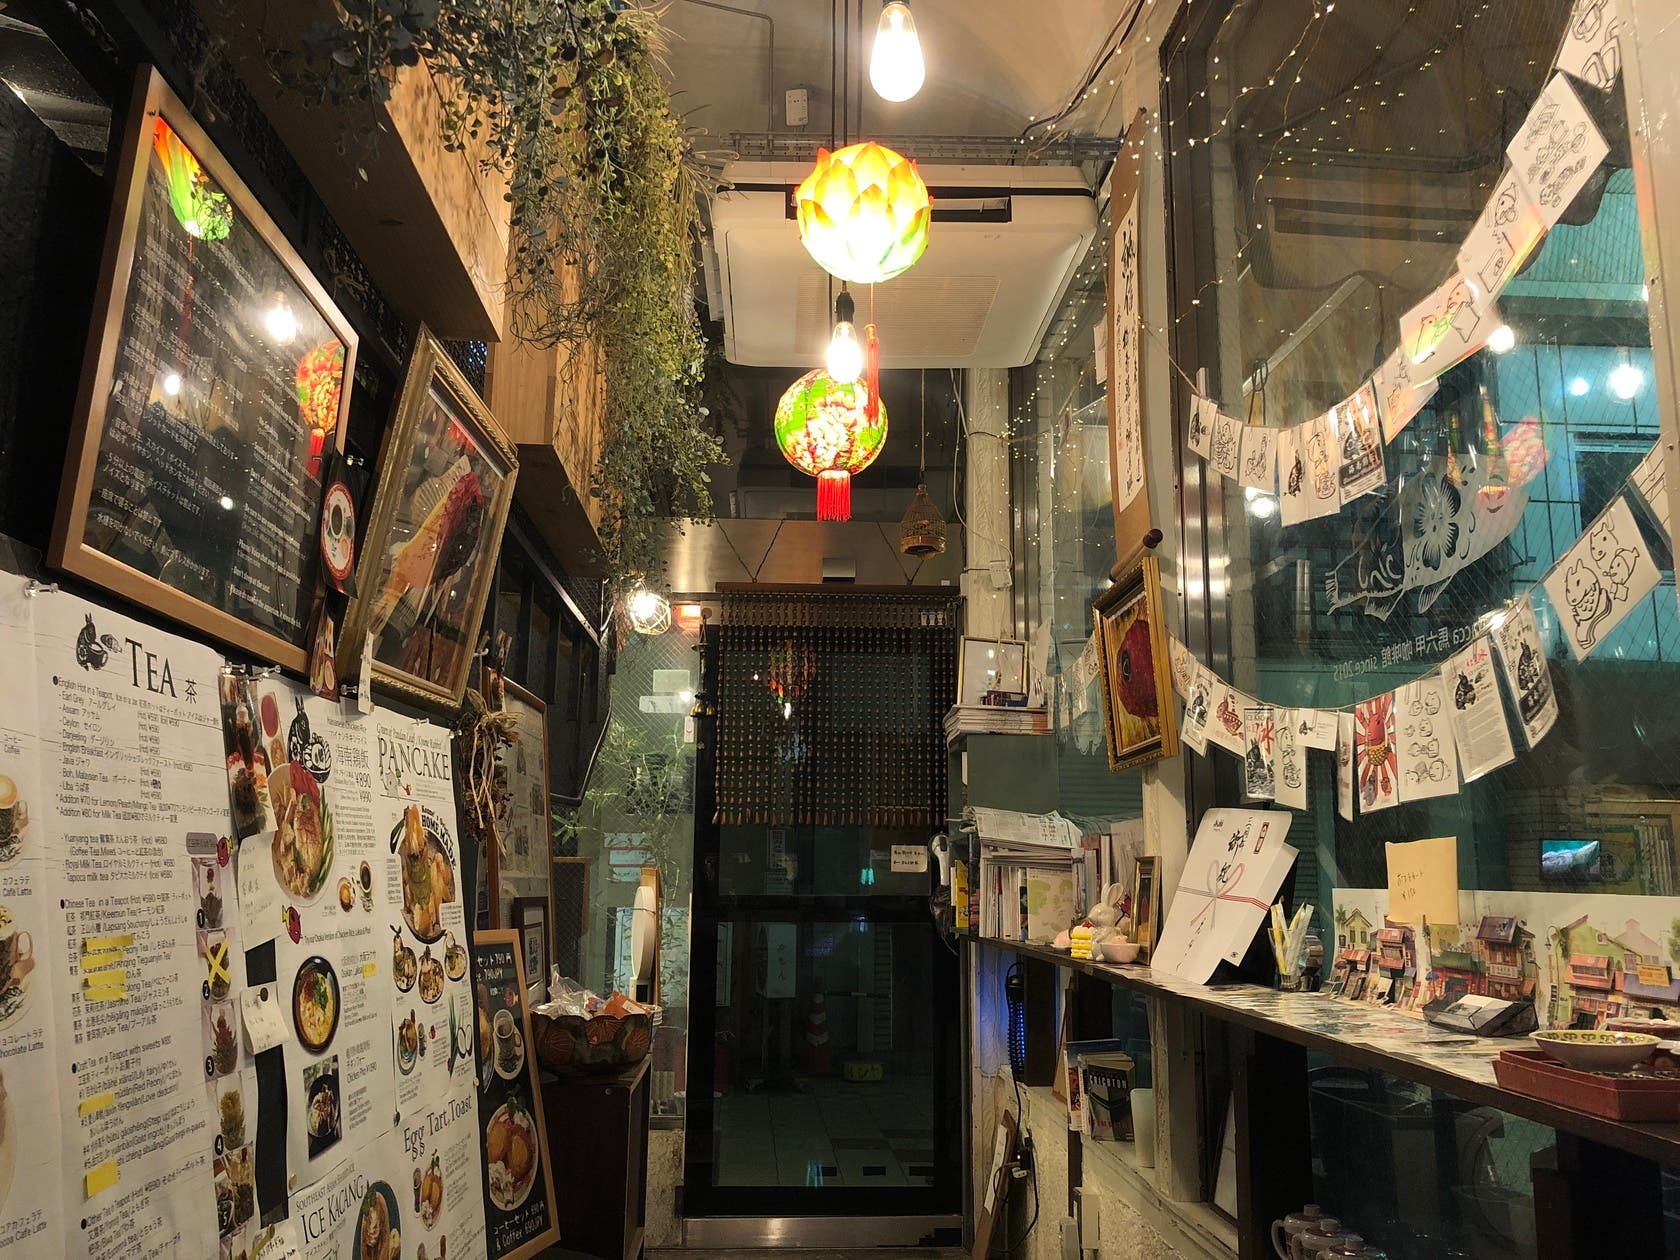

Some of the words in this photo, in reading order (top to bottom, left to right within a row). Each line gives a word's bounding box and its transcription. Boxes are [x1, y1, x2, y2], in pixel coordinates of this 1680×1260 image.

[125, 637, 178, 698] TEA
[185, 678, 198, 704] 茶
[62, 705, 79, 717] Assam
[377, 735, 450, 781] PANCAKE
[356, 771, 371, 789] ¥890
[16, 886, 32, 897] Latte
[28, 1040, 45, 1053] Latte
[207, 1057, 213, 1073] 3
[1089, 1074, 1128, 1090] CRICHTON
[404, 1127, 426, 1162] Egg
[427, 1112, 449, 1137] Tart
[449, 1095, 472, 1122] Toast
[216, 1138, 222, 1151] 4
[301, 1207, 326, 1244] ICE
[327, 1174, 363, 1226] KACANG
